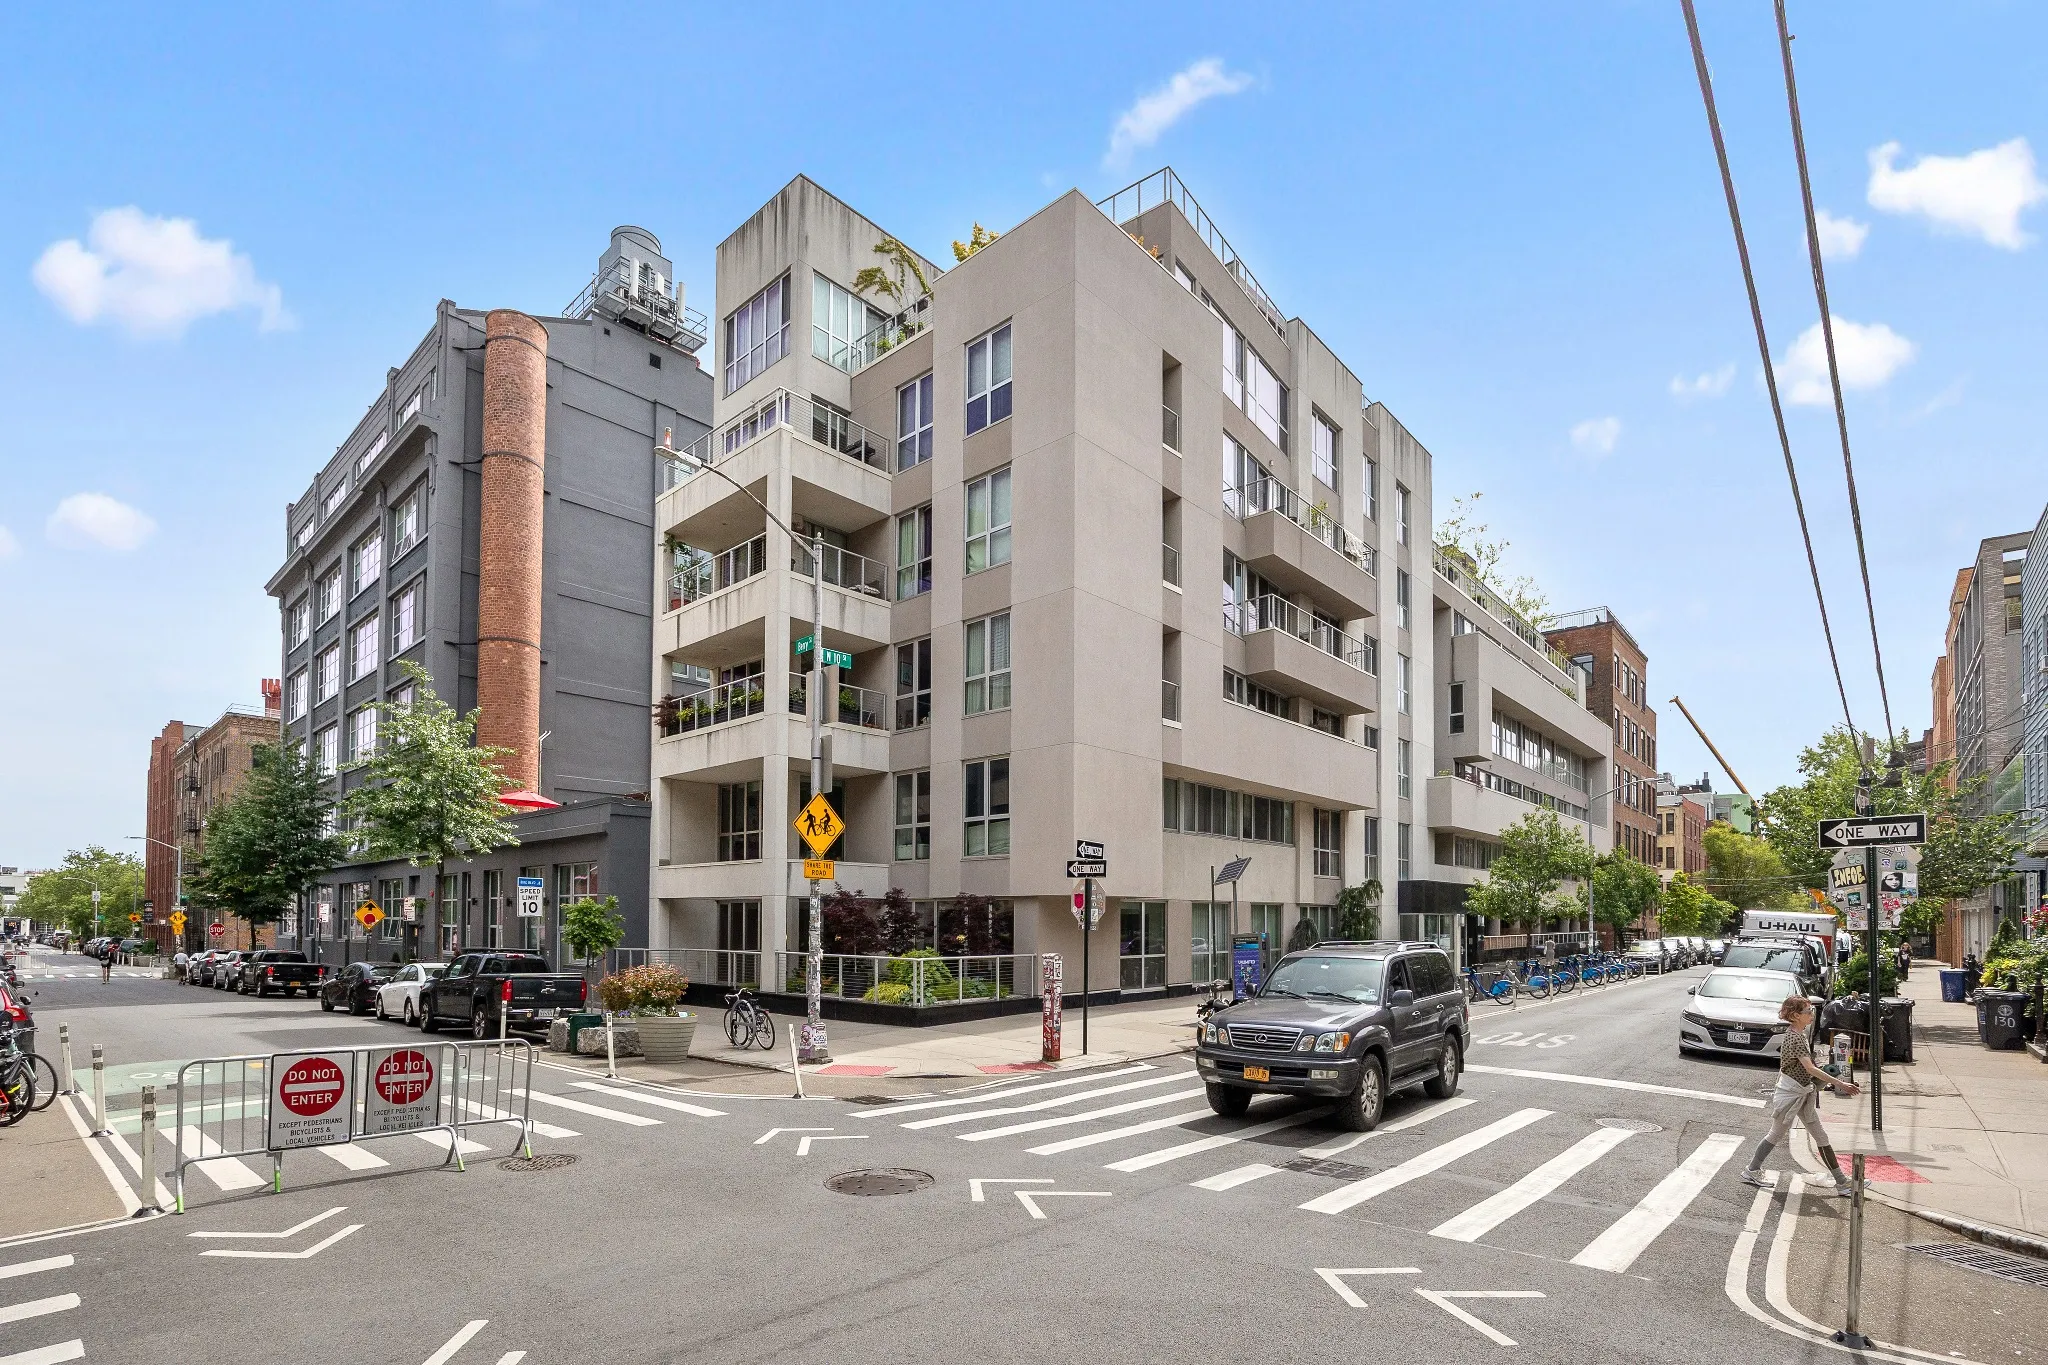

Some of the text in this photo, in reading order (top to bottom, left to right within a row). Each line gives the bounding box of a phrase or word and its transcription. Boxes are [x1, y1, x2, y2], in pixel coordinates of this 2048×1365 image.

[826, 650, 831, 662] N
[833, 652, 841, 664] 10
[1835, 824, 1911, 839] ONE WAY
[1080, 845, 1101, 855] ONE WAY
[1072, 865, 1102, 873] ONE WAY
[522, 901, 538, 914] 10
[1758, 920, 1820, 933] U-HAUL
[1993, 1015, 2017, 1029] 130
[383, 1060, 425, 1073] DO NOT
[288, 1068, 338, 1082] DO NOT
[384, 1083, 422, 1095] ENTER
[291, 1092, 333, 1106] ENTER
[278, 1117, 343, 1130] EXCEPT PEDESTRIANS
[290, 1126, 324, 1137] BICYCLISTS
[285, 1137, 305, 1146] LOCAL
[306, 1133, 335, 1144] VEHICLES
